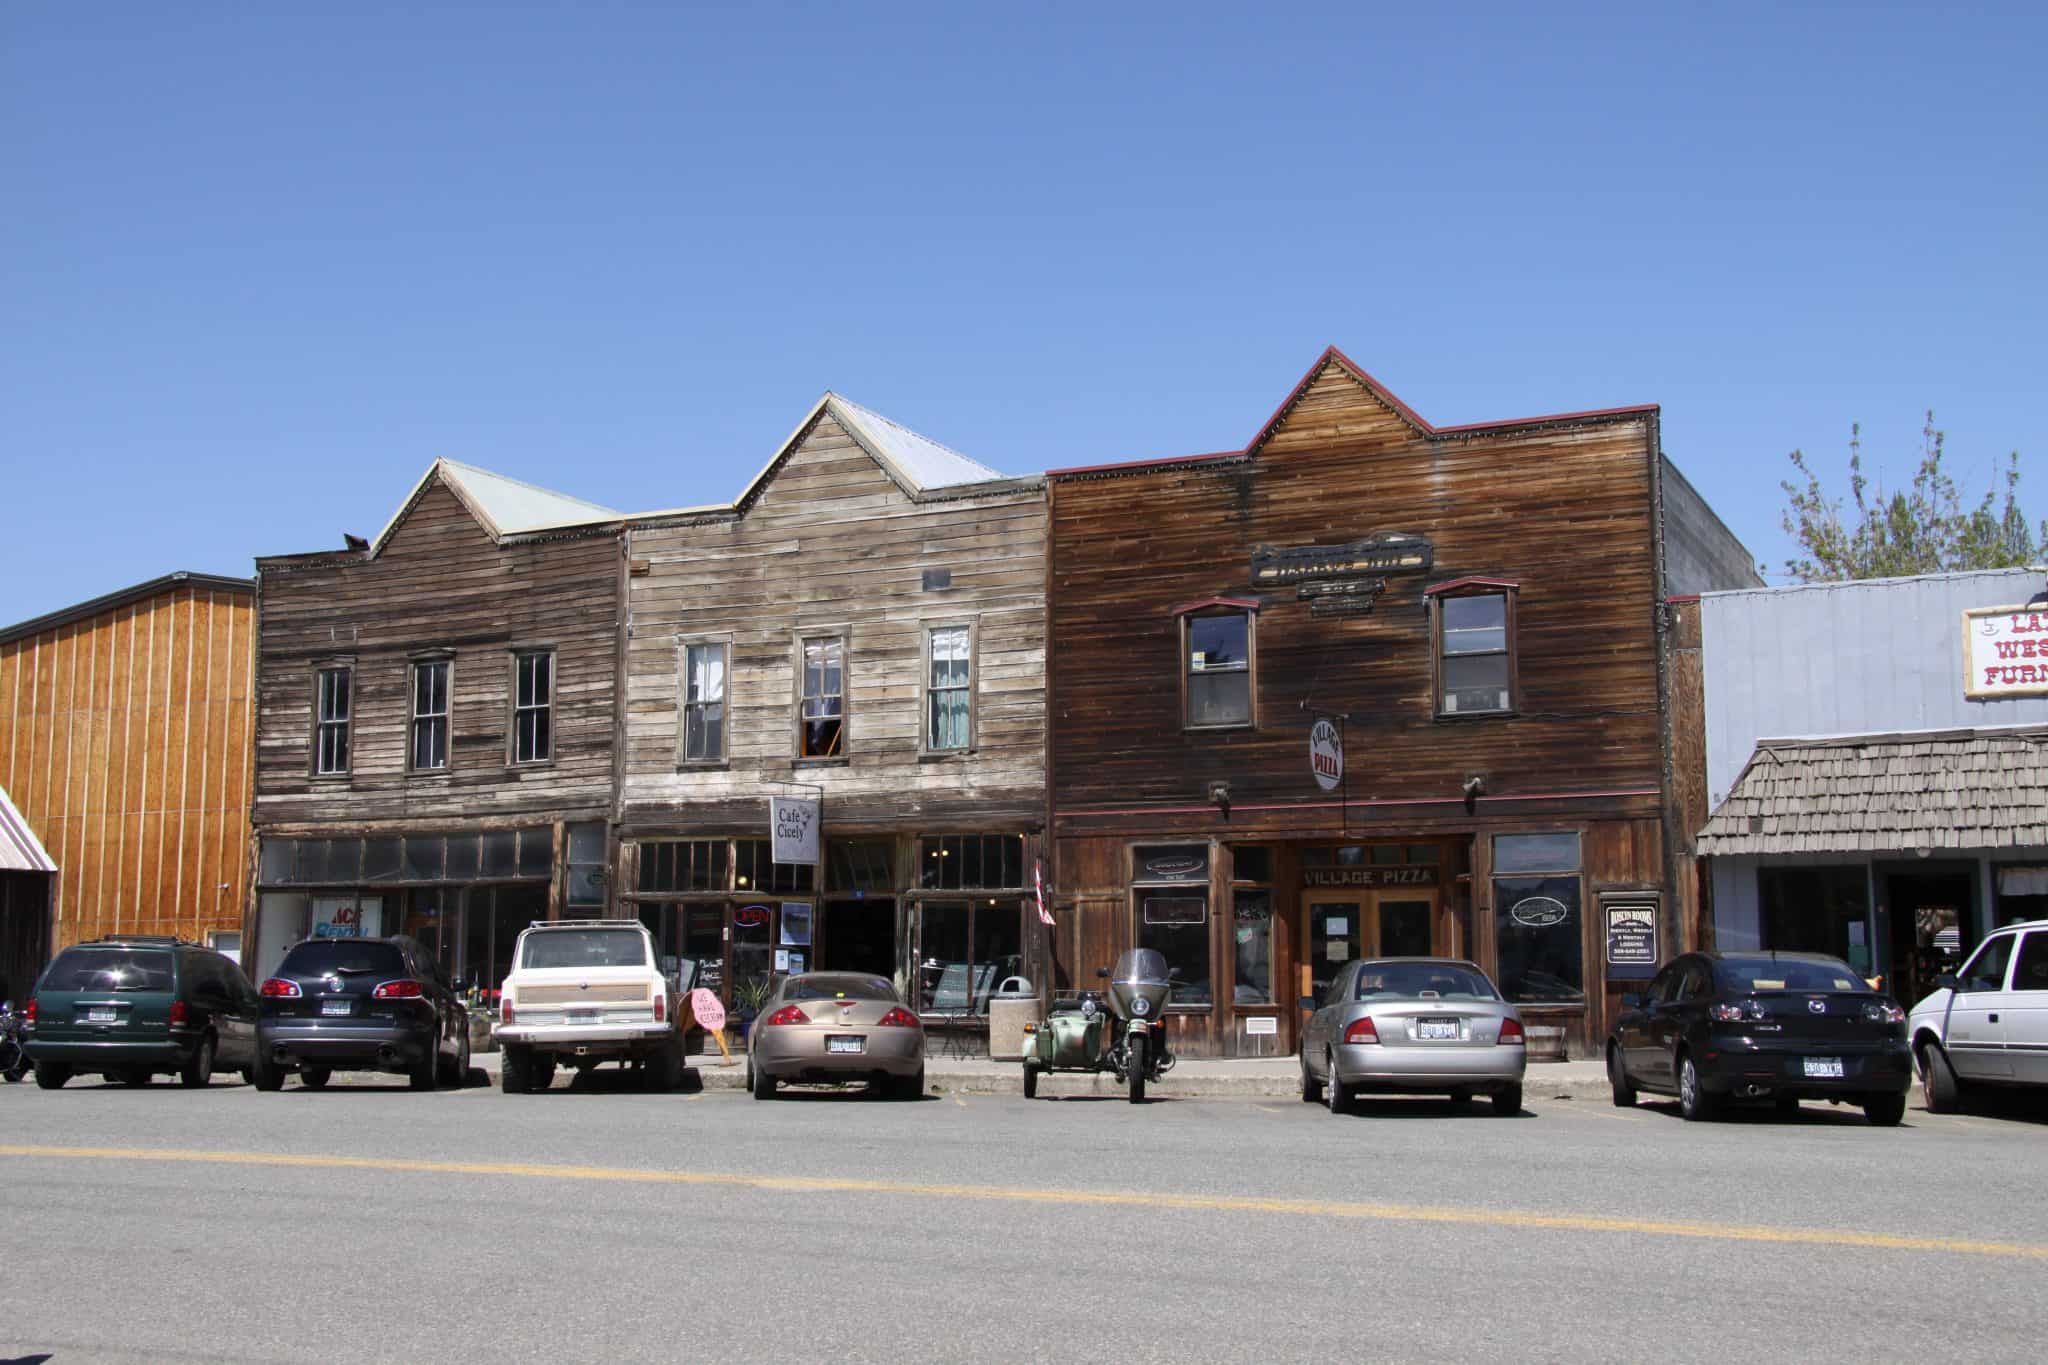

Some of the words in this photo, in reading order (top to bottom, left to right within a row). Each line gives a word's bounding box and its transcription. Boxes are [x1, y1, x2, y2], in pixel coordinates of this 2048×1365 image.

[1994, 638, 2048, 659] WES
[1312, 723, 1339, 755] VILLAGE
[1315, 751, 1339, 777] PIZZA
[779, 808, 800, 822] Cafe
[777, 823, 804, 843] Cicely
[1304, 871, 1375, 885] VILLAGE
[1383, 869, 1433, 884] PIZZA
[734, 909, 769, 922] OPEN
